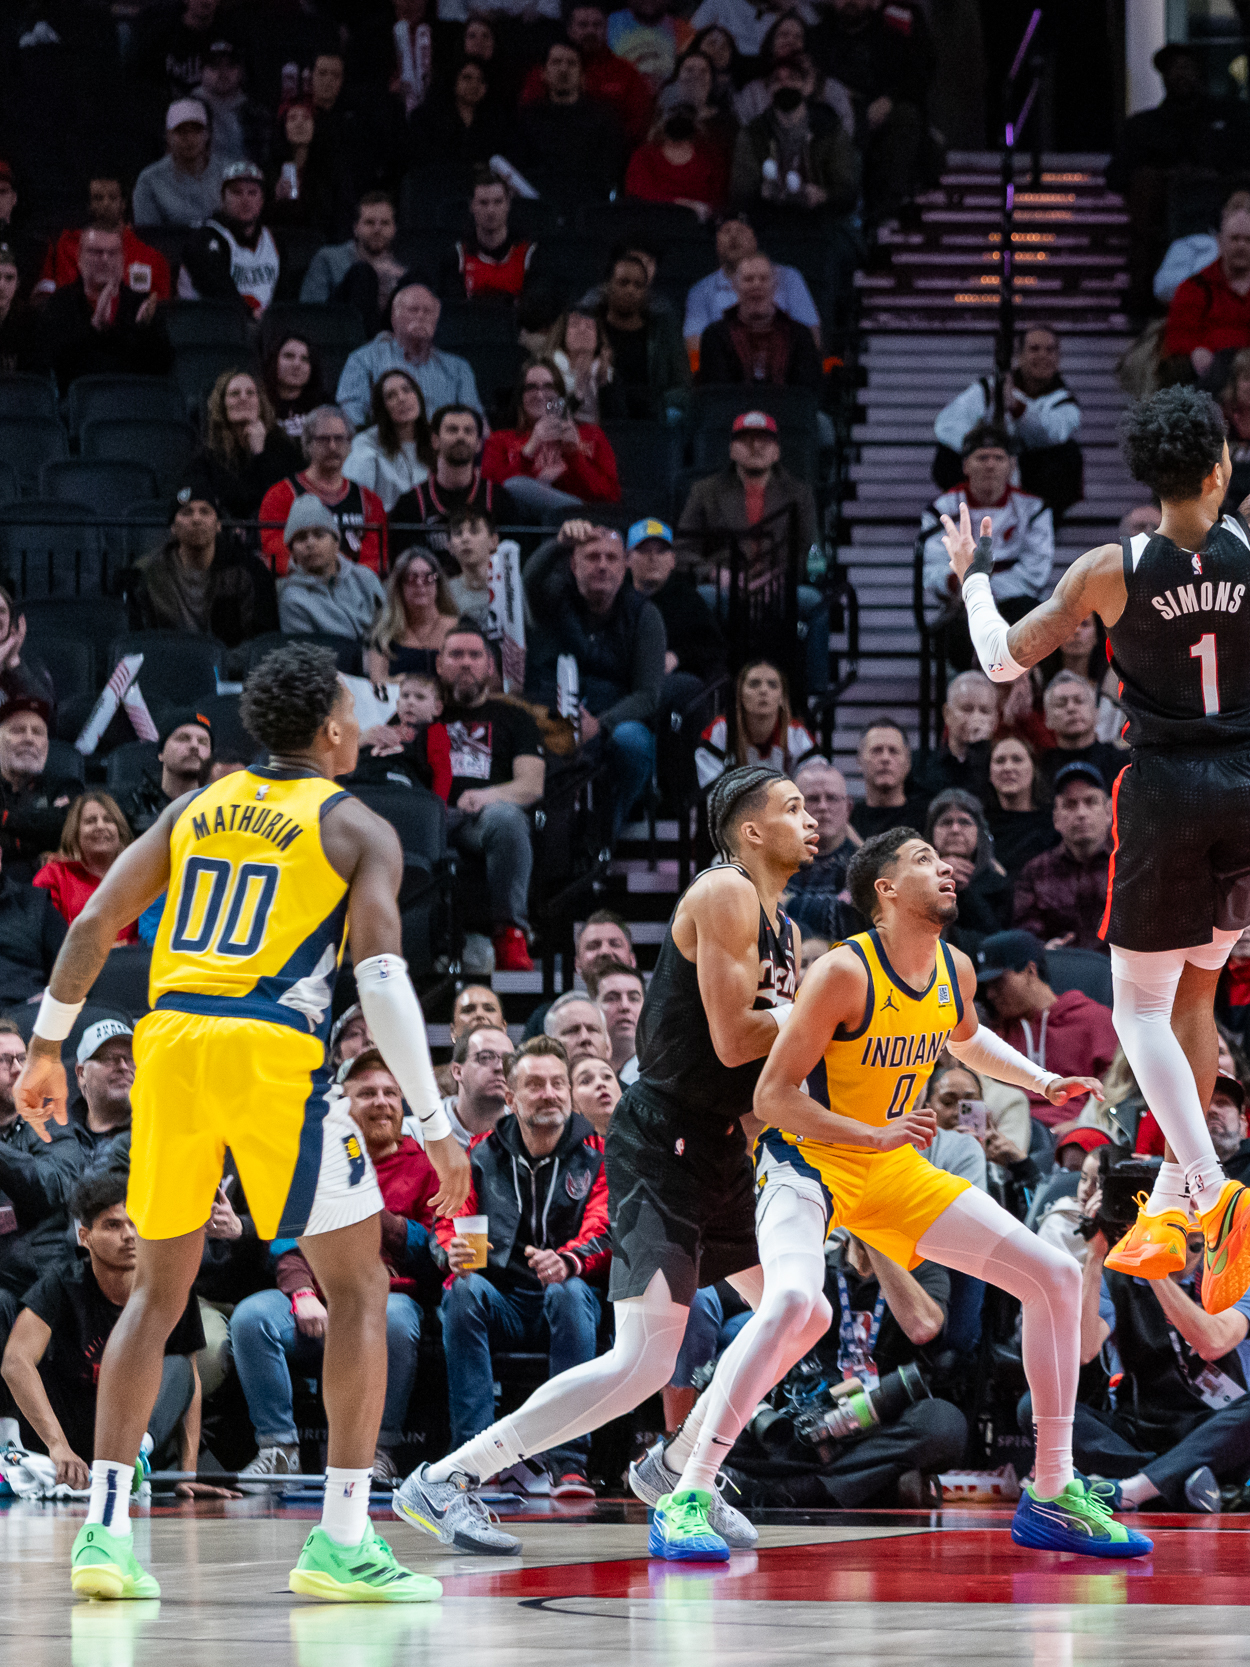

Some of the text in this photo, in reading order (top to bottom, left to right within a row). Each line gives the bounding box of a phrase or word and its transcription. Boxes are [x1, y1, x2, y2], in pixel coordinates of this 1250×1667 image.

[1151, 581, 1246, 620] SIMONS
[1189, 632, 1221, 717] 1
[192, 804, 303, 852] MATHURIN
[170, 855, 280, 957] 00
[886, 1073, 917, 1120] 0
